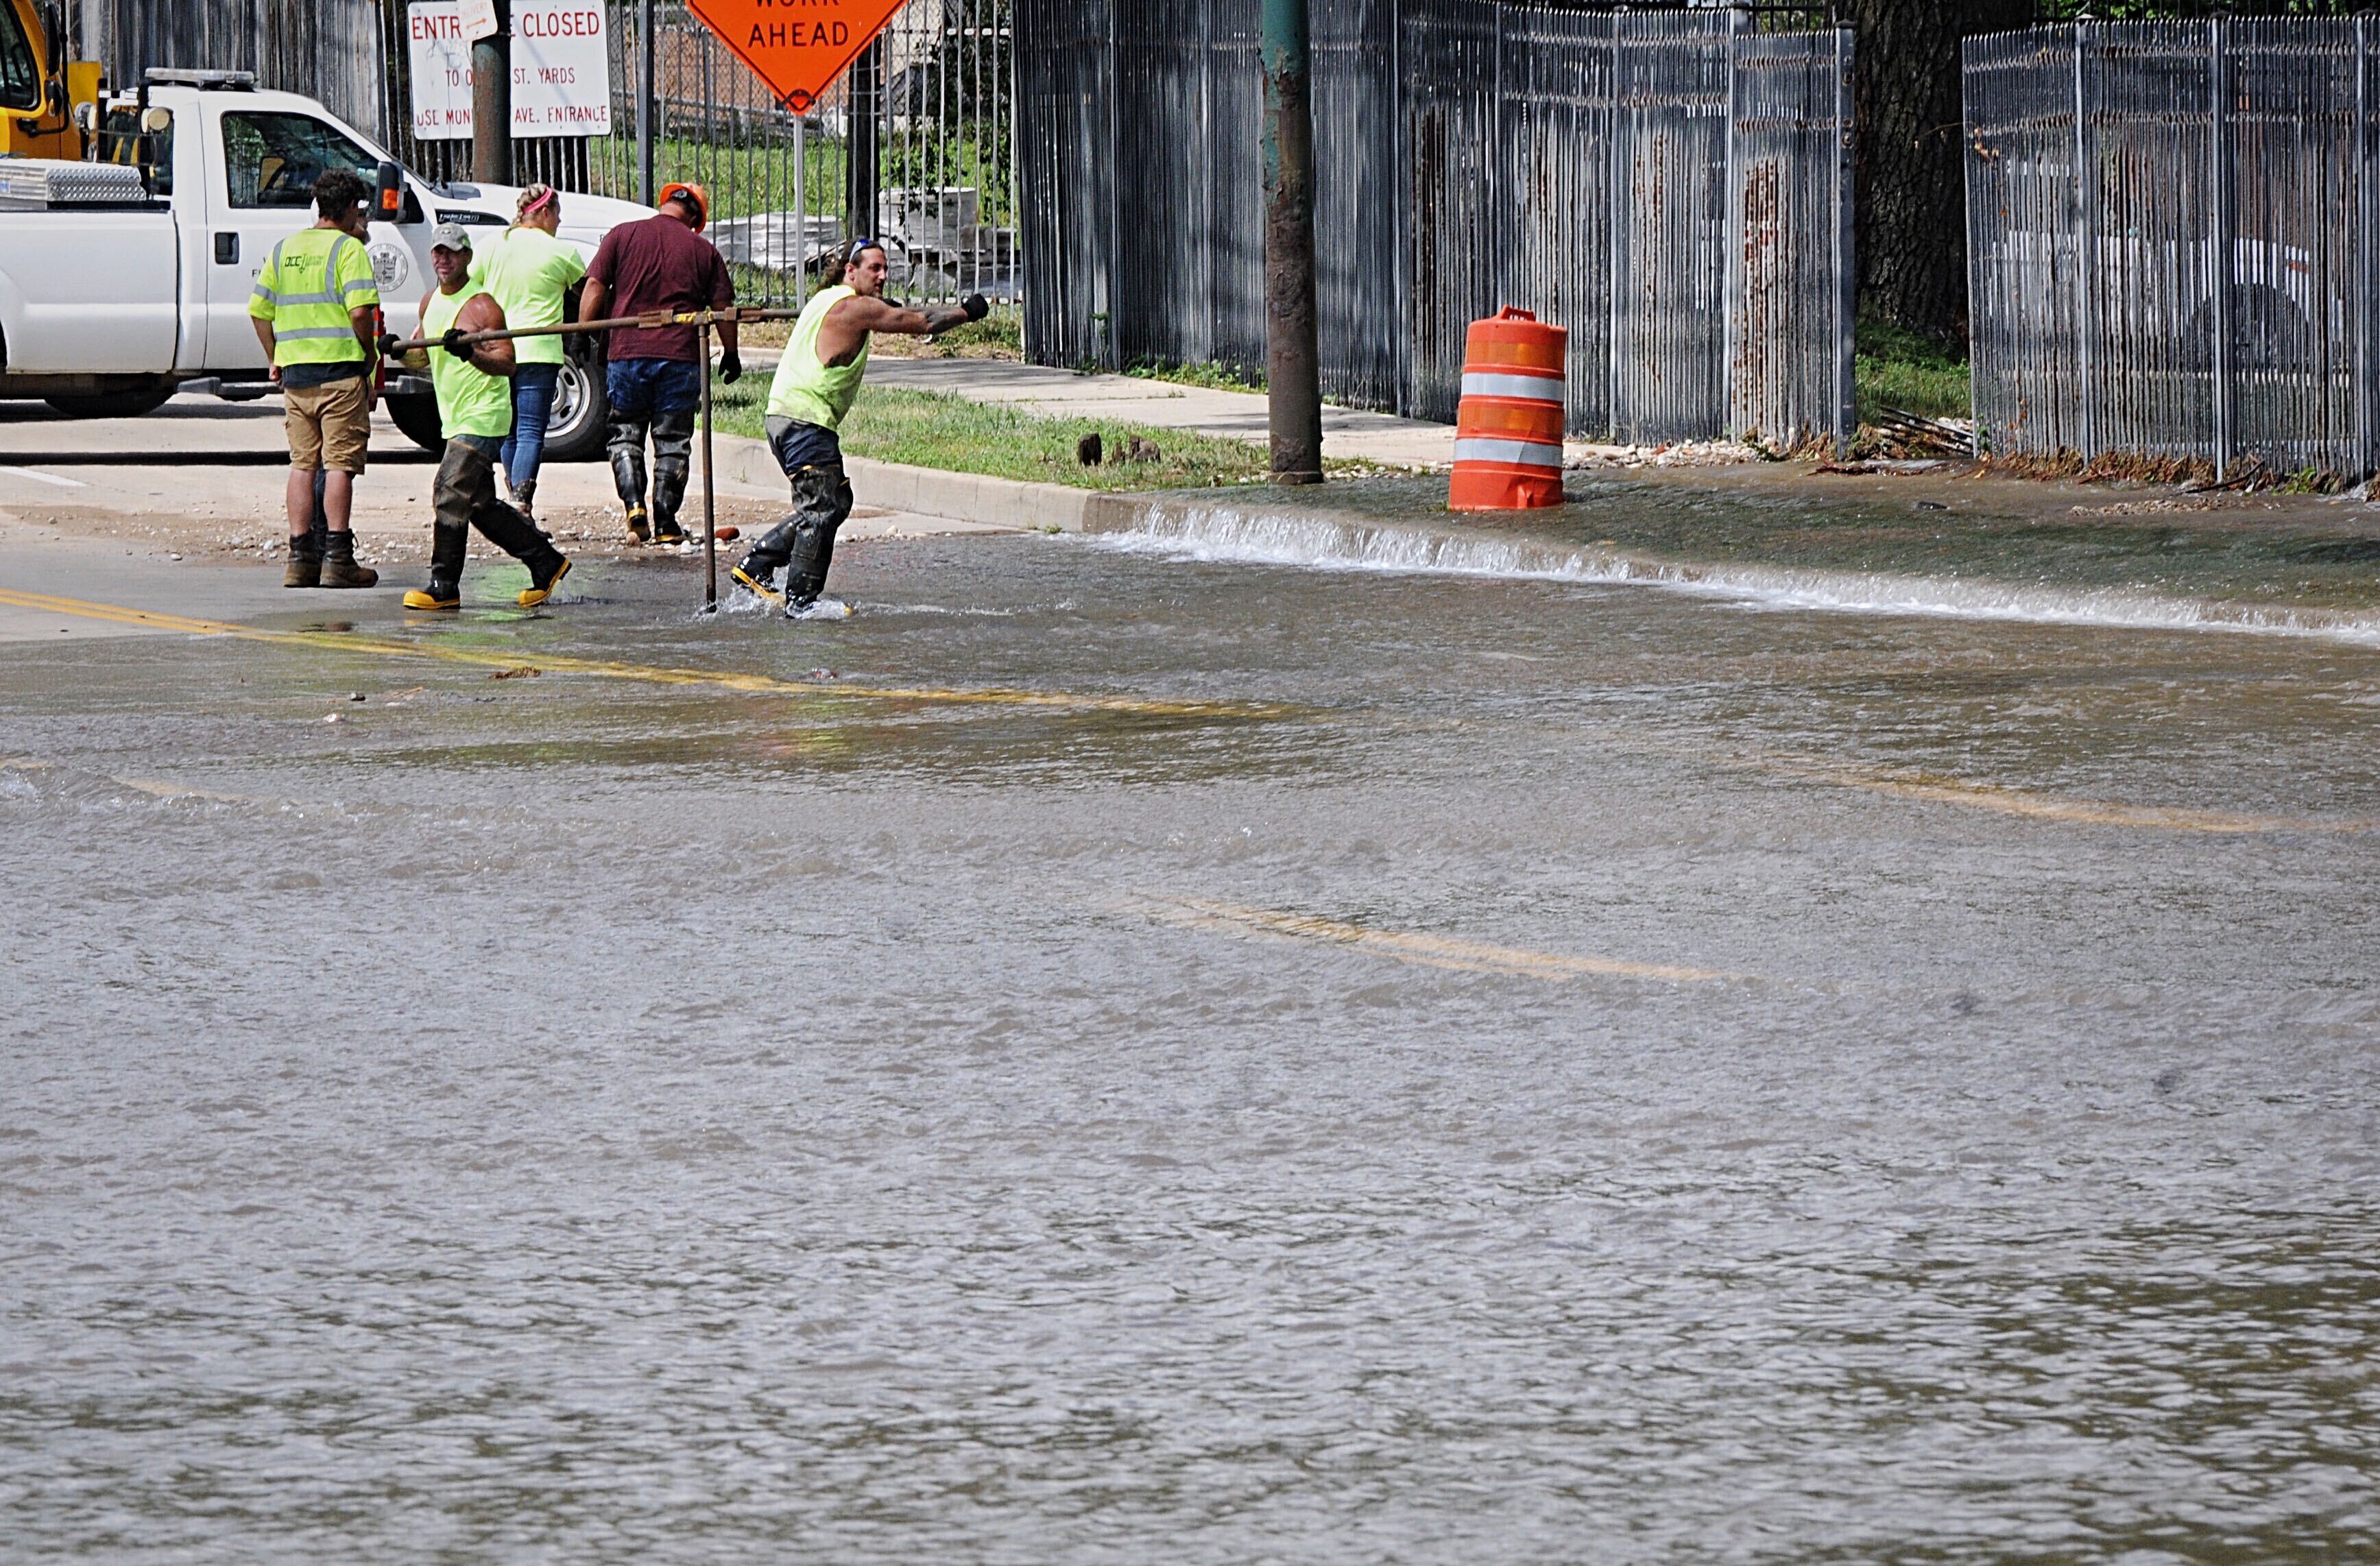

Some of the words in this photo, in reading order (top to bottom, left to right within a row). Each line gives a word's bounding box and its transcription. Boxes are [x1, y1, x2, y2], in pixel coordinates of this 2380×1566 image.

[523, 12, 599, 37] CLOSED
[747, 21, 848, 48] AHEAD
[446, 69, 459, 86] TO
[514, 67, 531, 84] ST.
[538, 67, 575, 84] YARDS
[417, 109, 439, 126] USE
[515, 107, 540, 123] AVE.
[548, 106, 607, 123] ENTRANCE
